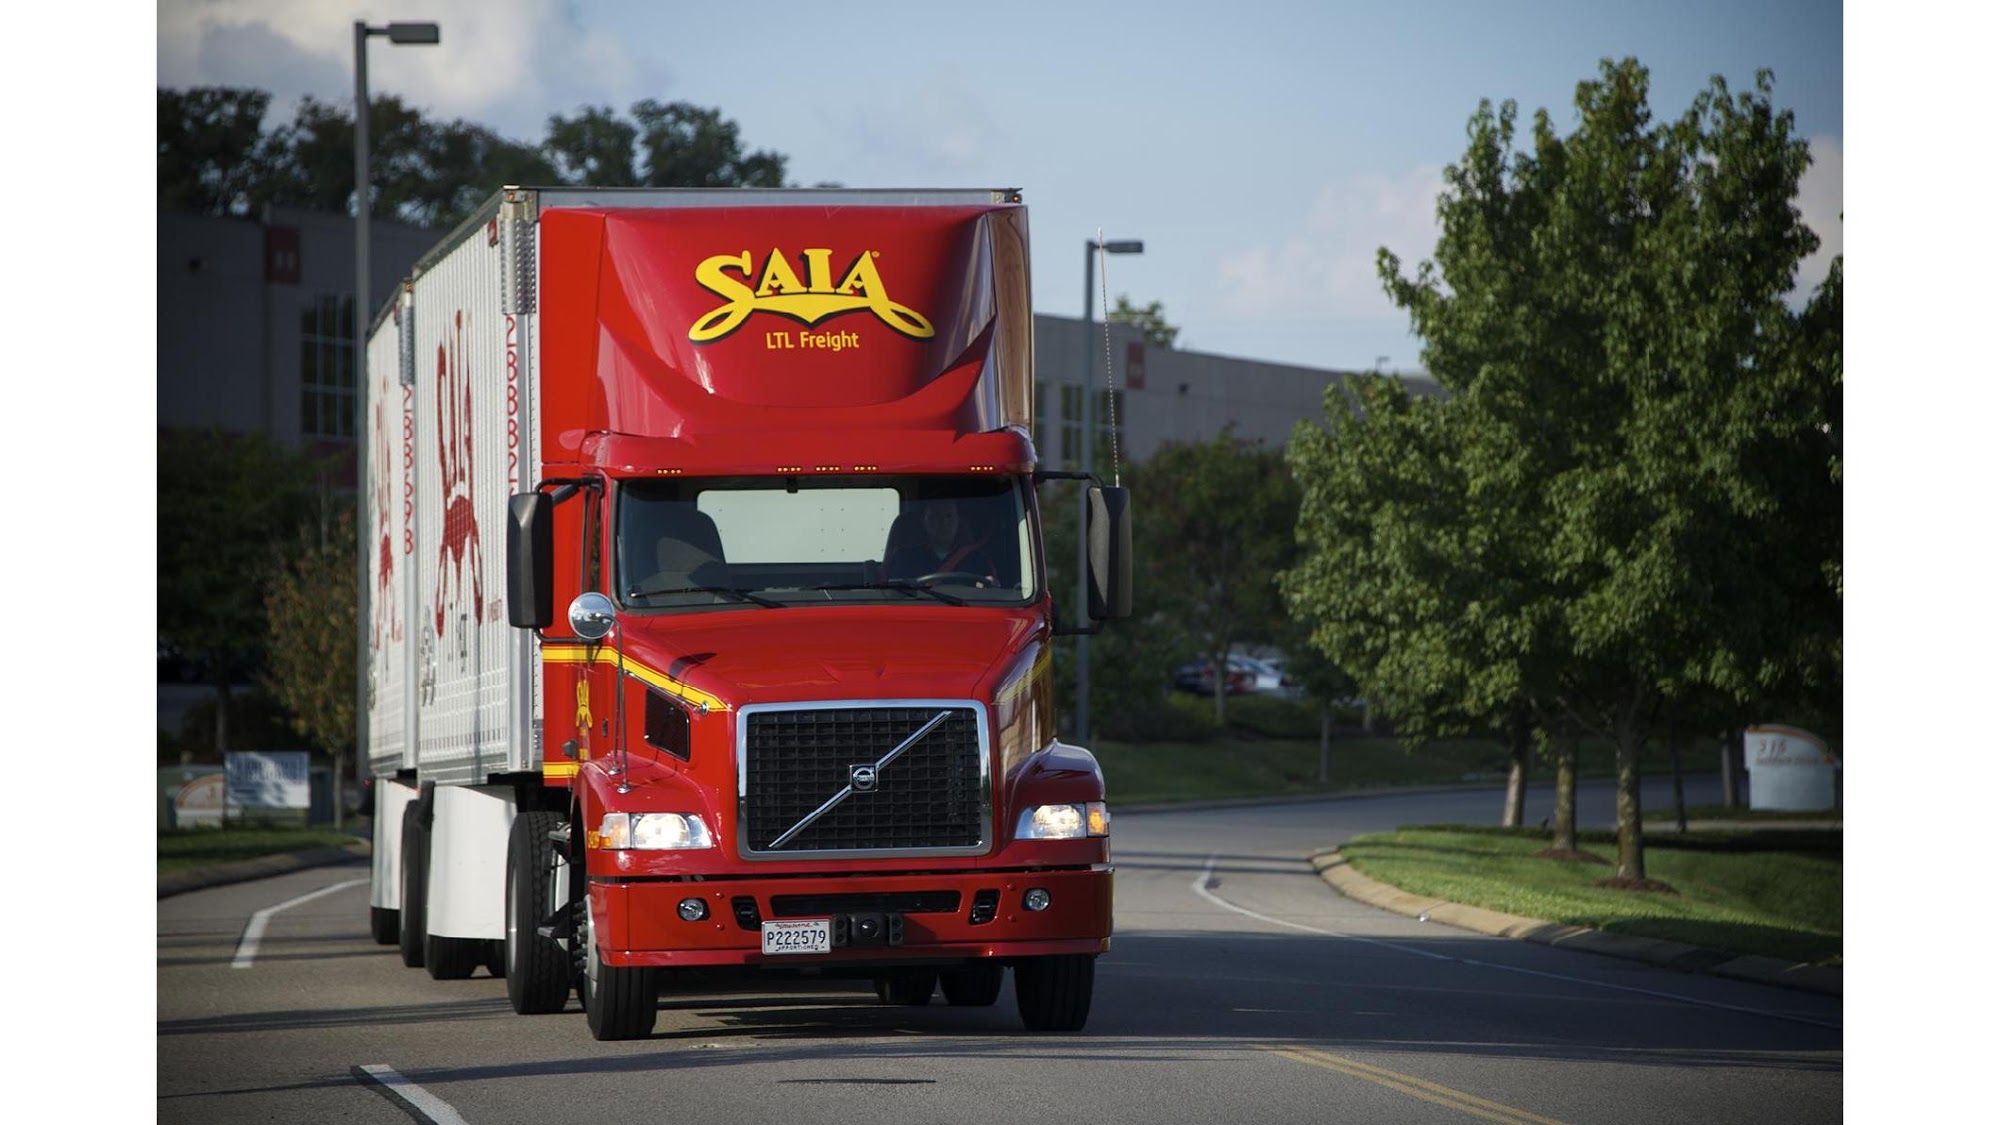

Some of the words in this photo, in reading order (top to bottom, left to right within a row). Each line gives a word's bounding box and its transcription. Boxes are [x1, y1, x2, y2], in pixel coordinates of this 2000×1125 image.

[688, 247, 935, 341] SAIA
[766, 332, 795, 350] LTL
[800, 330, 859, 351] Freight
[506, 316, 519, 497] 28882
[767, 930, 826, 946] P222579
